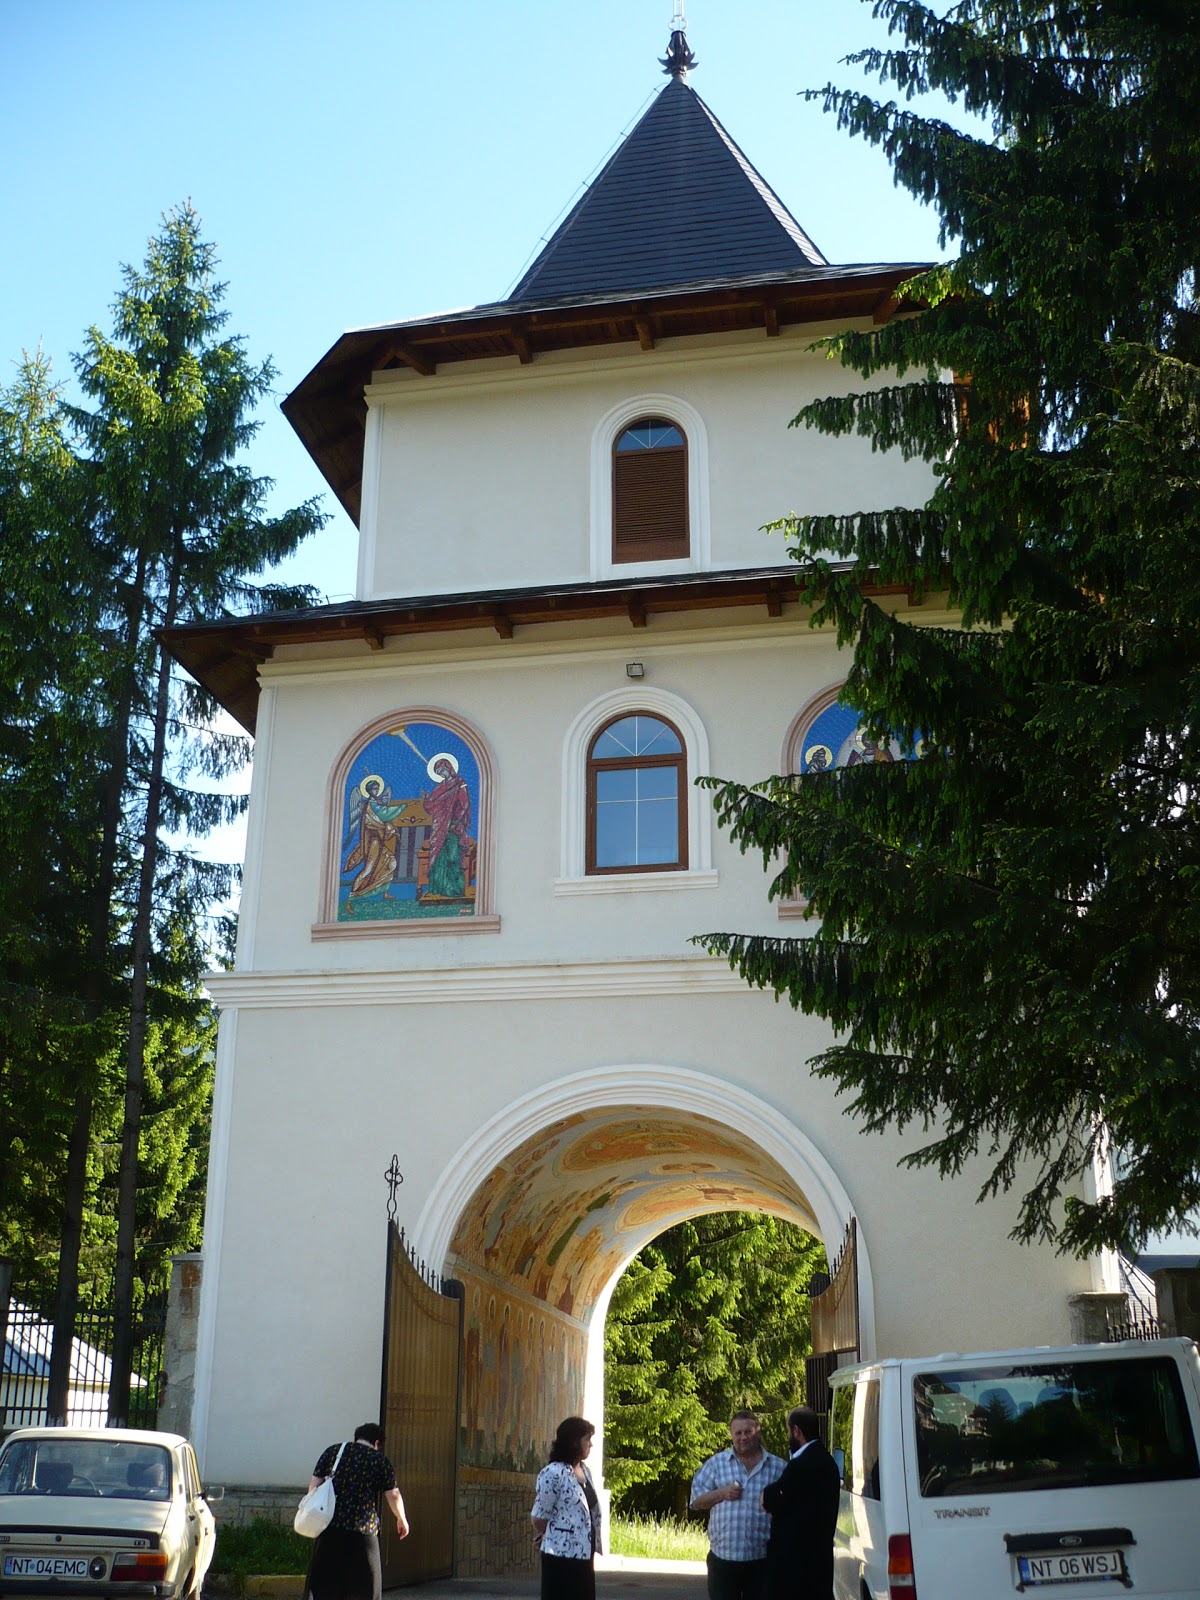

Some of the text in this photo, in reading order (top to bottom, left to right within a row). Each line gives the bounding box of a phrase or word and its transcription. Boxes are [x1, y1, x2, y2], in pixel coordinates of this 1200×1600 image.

[934, 1507, 990, 1518] TRANSIT
[12, 1559, 33, 1574] NT
[1030, 1559, 1053, 1578] NT
